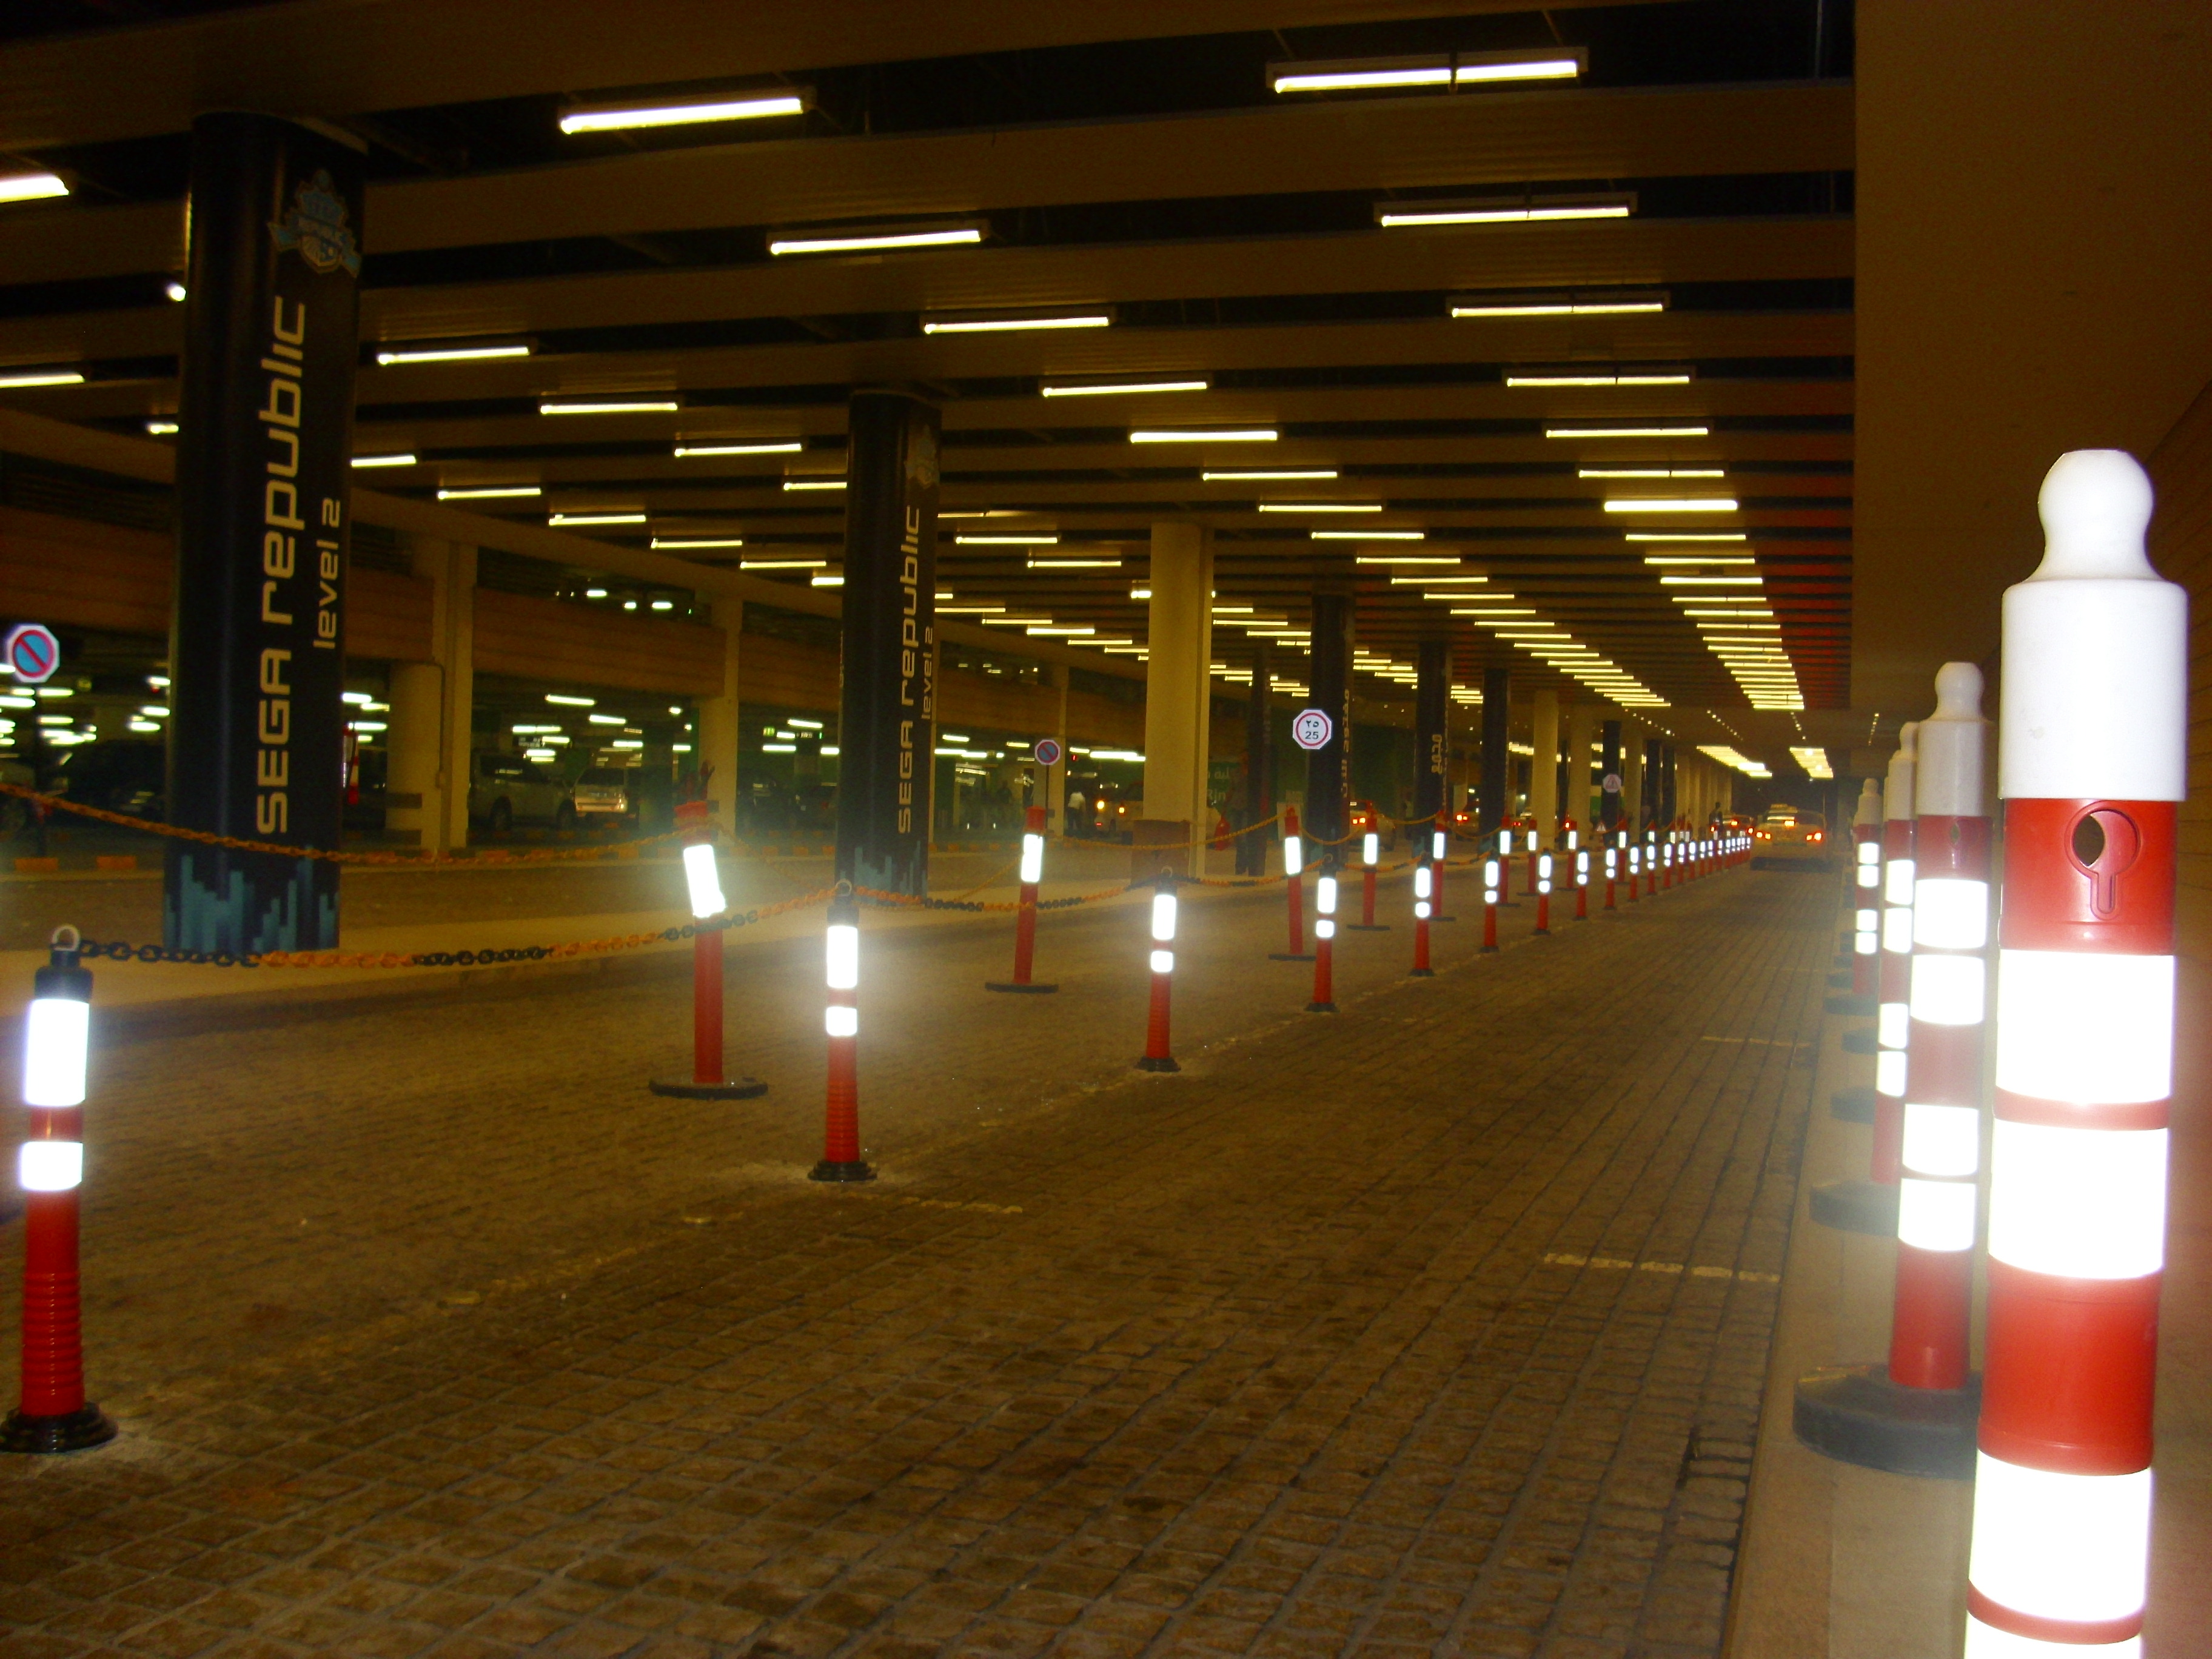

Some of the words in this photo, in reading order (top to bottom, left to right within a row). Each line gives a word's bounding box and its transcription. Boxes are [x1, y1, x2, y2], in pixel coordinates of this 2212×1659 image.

[259, 296, 305, 625] republic
[322, 498, 340, 527] 2
[313, 539, 338, 649] level
[900, 504, 919, 706] republic
[925, 626, 933, 645] 2
[920, 652, 932, 720] level
[1305, 719, 1319, 728] ٢٥
[256, 648, 292, 834] SEGA
[897, 720, 913, 834] SEGA
[1305, 731, 1319, 740] 25
